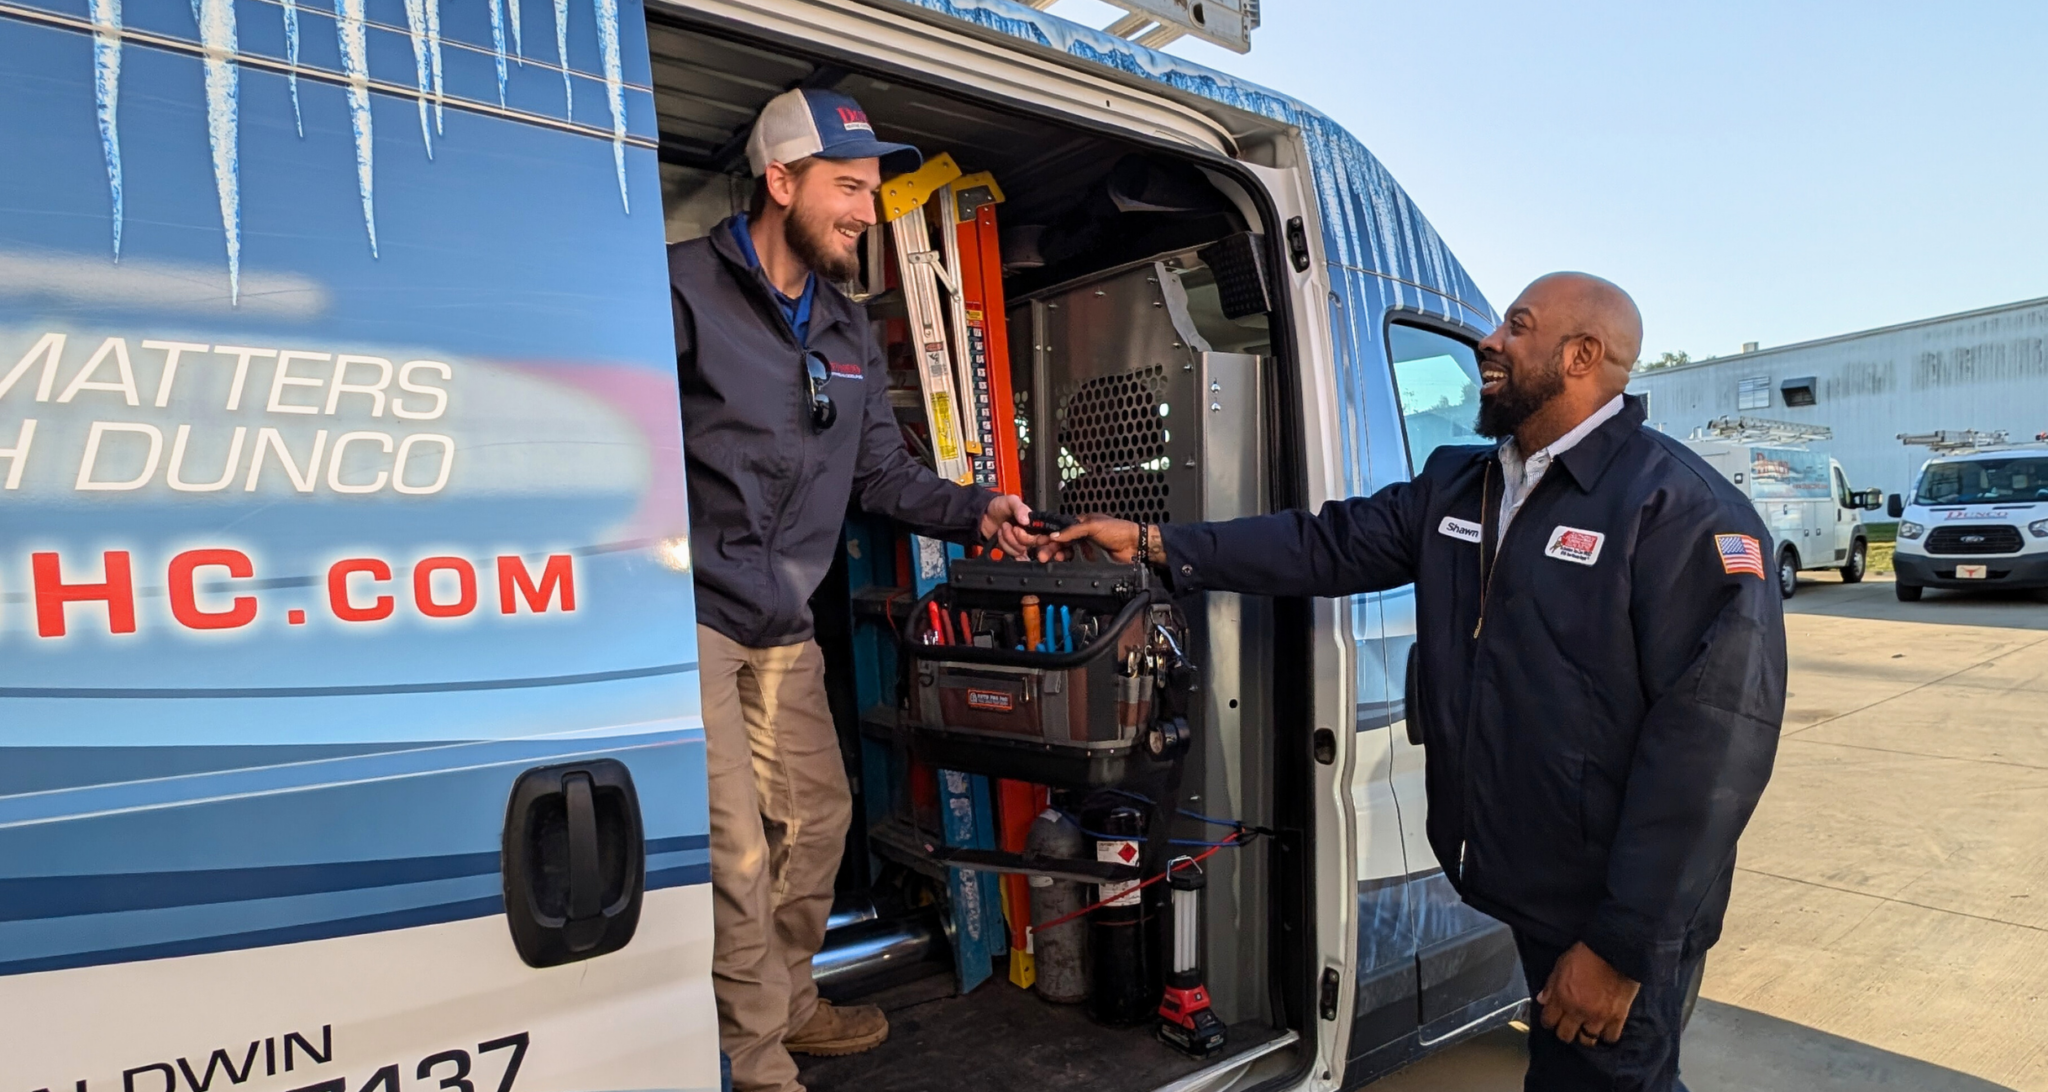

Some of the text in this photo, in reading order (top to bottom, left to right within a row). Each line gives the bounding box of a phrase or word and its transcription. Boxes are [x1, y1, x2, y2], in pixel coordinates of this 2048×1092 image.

[75, 421, 455, 495] DUNCO
[1446, 521, 1479, 538] Shawn
[31, 549, 577, 638] HC.COM
[32, 1024, 333, 1092] DWIN
[286, 1030, 530, 1092] 37
